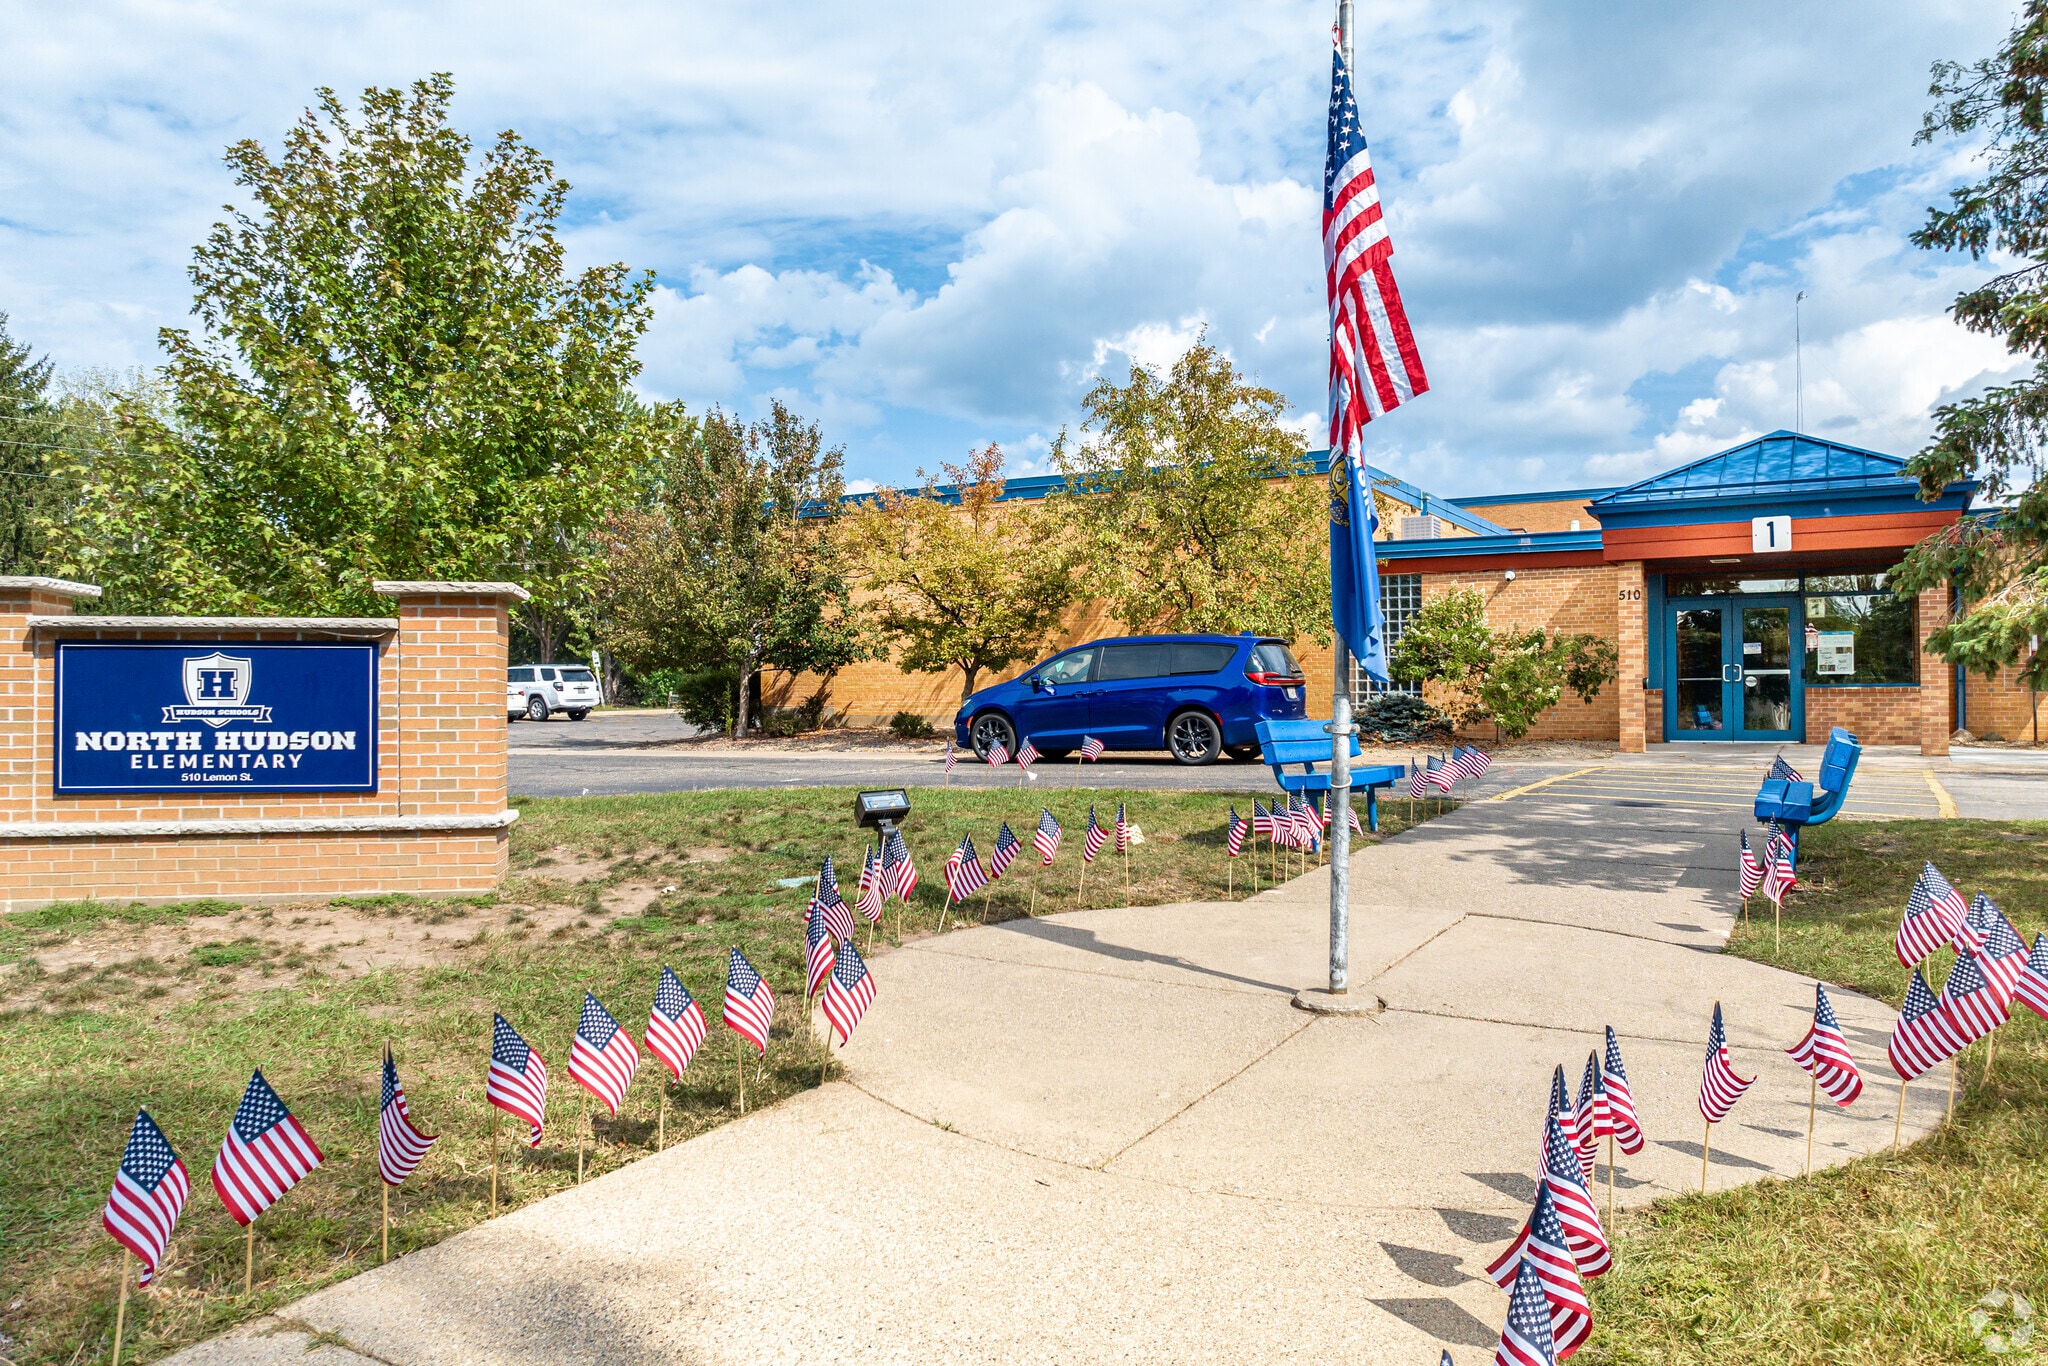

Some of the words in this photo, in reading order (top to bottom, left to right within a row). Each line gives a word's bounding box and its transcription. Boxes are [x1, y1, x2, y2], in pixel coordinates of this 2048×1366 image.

[1766, 521, 1775, 547] 1
[1618, 589, 1641, 601] 510
[199, 670, 236, 698] H
[75, 731, 202, 751] NORTH
[214, 731, 357, 751] HUDSON
[130, 753, 303, 769] ELEMENTARY
[181, 773, 201, 782] 510
[202, 773, 238, 782] Lemon
[239, 773, 254, 782] St.
